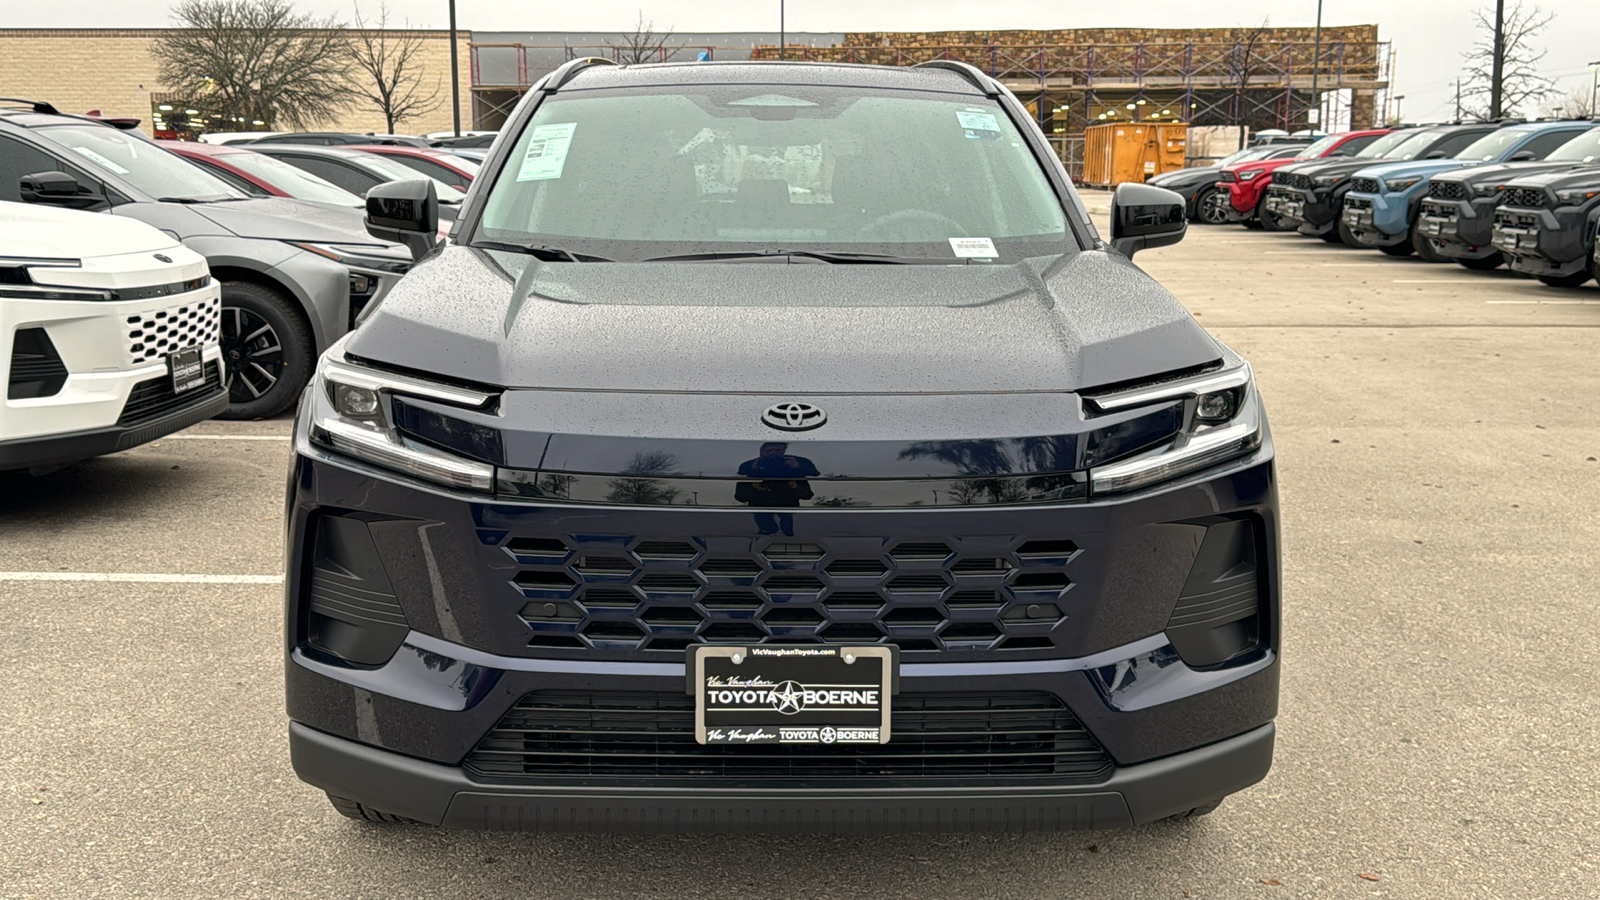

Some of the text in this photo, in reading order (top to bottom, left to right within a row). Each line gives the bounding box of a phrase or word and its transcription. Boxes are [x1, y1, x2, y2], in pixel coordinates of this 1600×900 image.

[752, 648, 836, 657] VicVaughanToyota.com
[706, 675, 774, 688] Vic Vaughan
[707, 690, 778, 704] TOYOTA
[803, 690, 879, 704] BOERNE
[707, 728, 879, 742] Vic Vaughan TOYOTA BOERNE
